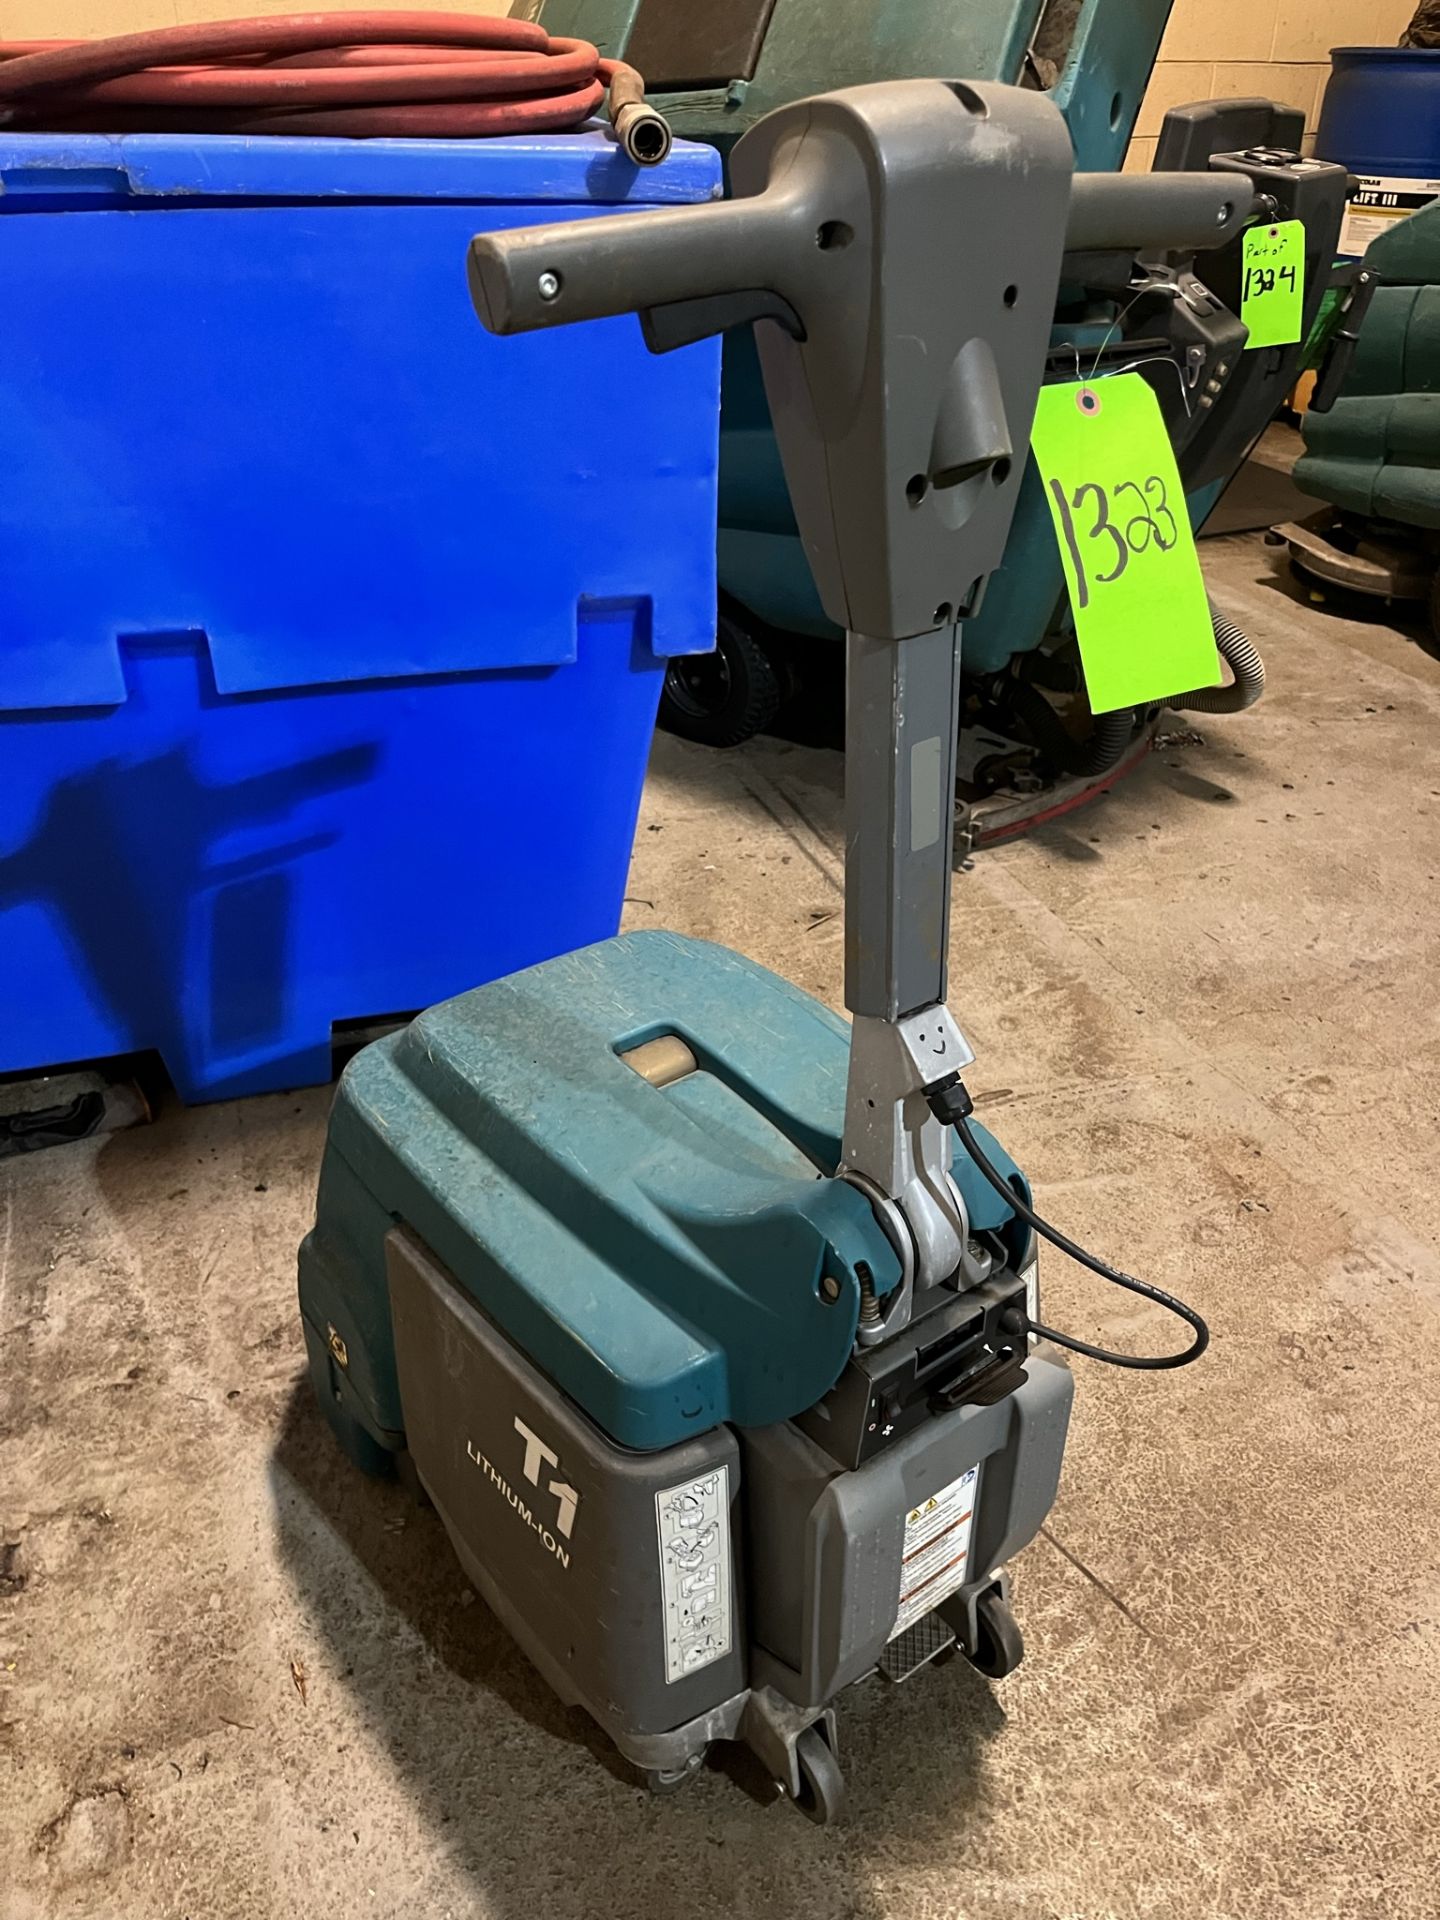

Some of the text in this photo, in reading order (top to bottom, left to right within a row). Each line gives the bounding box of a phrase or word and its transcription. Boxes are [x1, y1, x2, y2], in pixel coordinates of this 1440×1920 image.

[1353, 192, 1398, 206] LIFT III
[1243, 266, 1296, 302] 1324
[1272, 239, 1288, 255] of
[1050, 476, 1177, 608] 1323
[467, 1440, 570, 1568] LITHIUM-ION
[514, 1416, 579, 1540] T1
